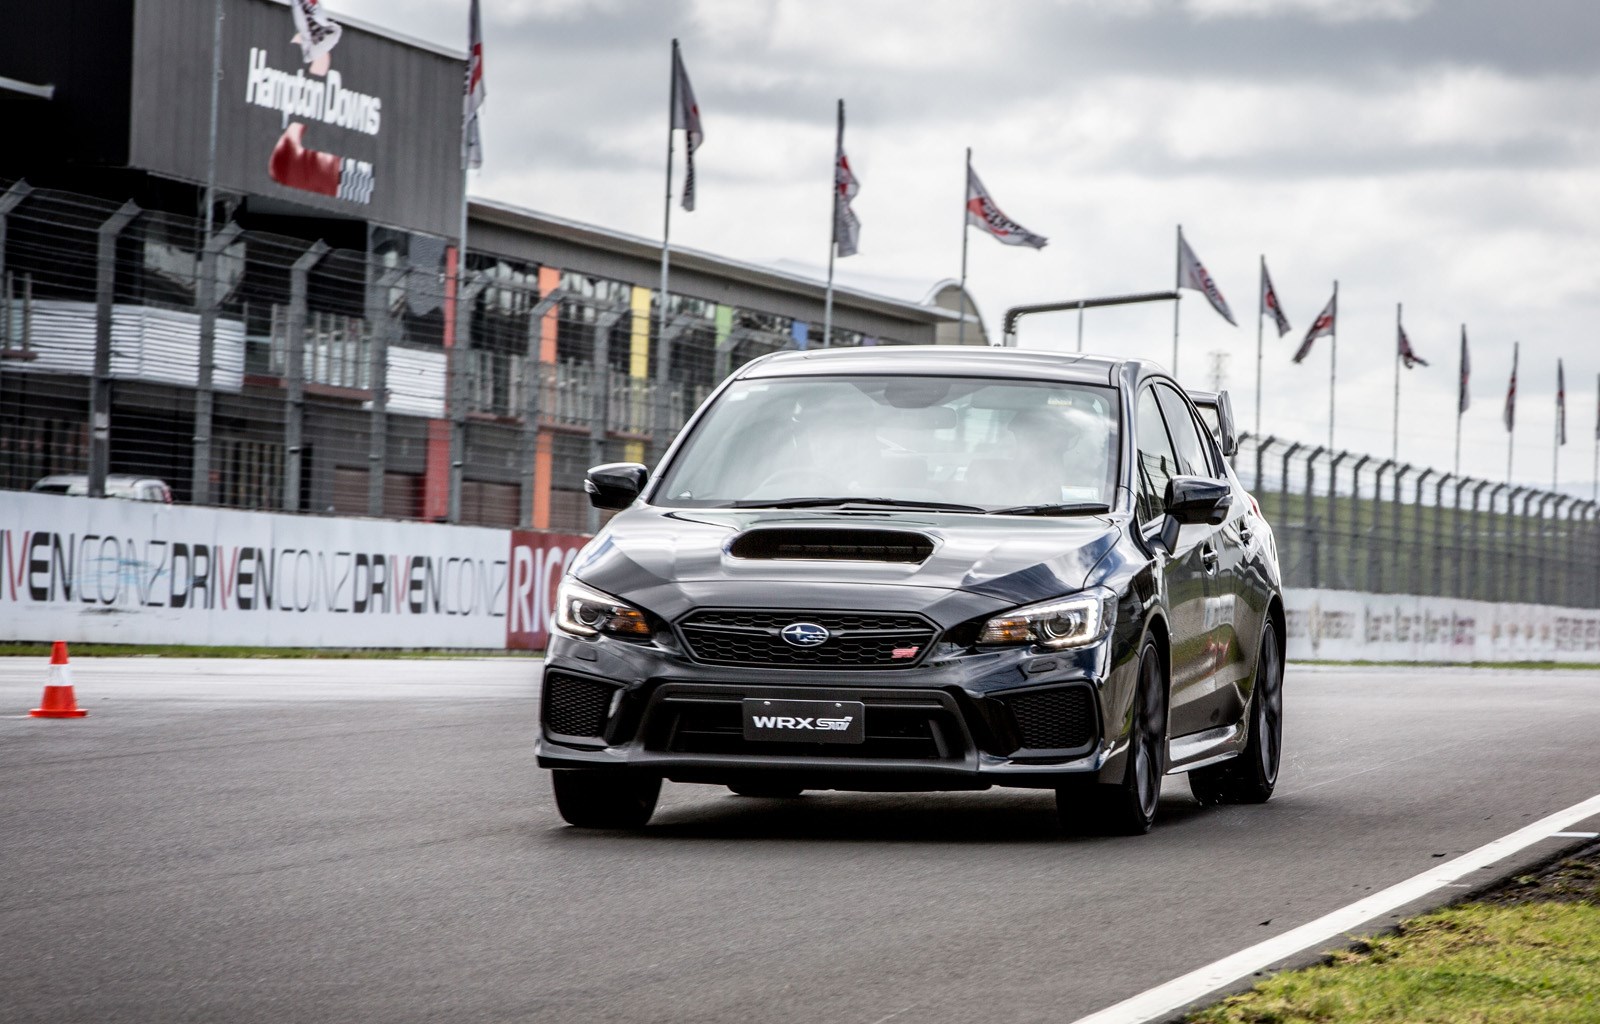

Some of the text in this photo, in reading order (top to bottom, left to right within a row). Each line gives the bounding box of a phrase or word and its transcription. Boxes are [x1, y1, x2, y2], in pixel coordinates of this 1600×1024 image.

[246, 47, 382, 136] Hampton Downs
[752, 715, 815, 730] WRX
